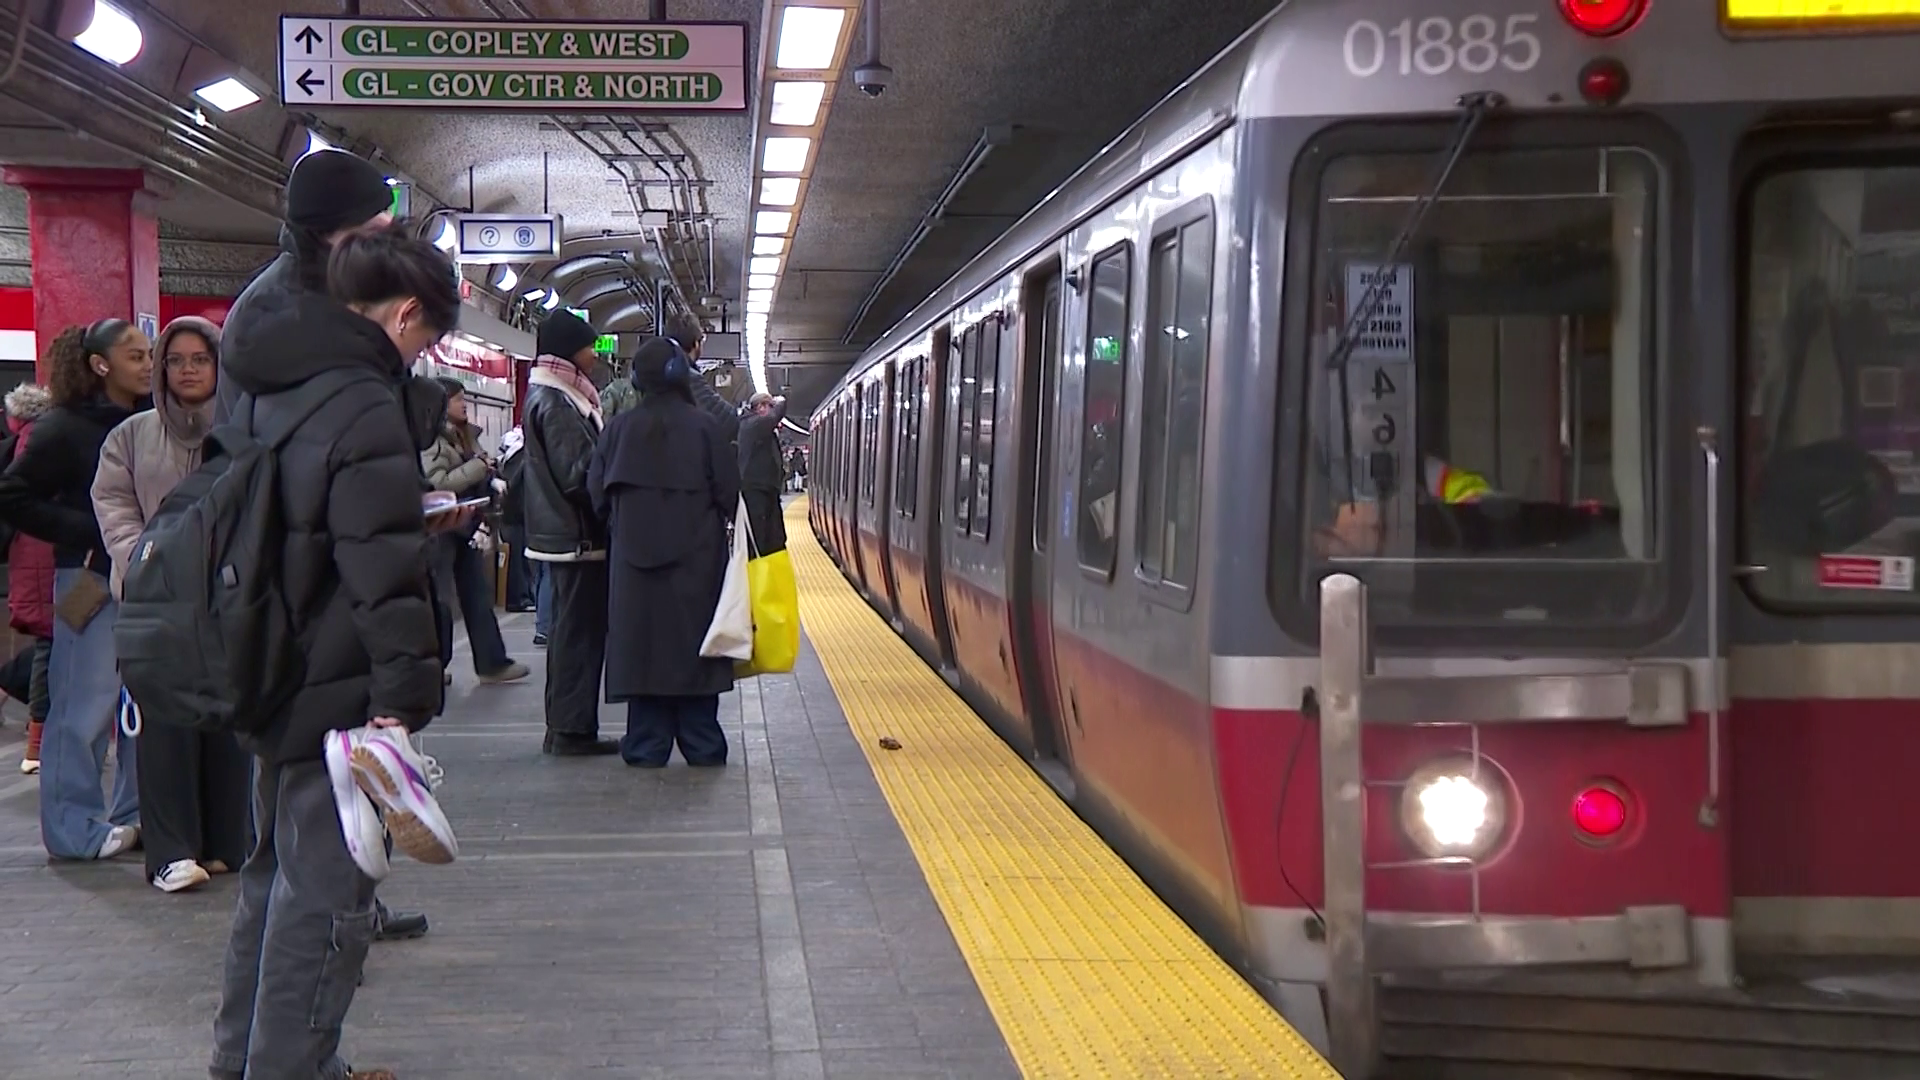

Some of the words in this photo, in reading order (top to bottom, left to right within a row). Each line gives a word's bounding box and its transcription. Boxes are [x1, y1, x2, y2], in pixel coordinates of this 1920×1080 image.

[356, 29, 398, 53] GL
[427, 30, 551, 55] COPLEY
[560, 32, 580, 55] &
[589, 33, 676, 56] WEST
[1343, 13, 1541, 77] 01885
[357, 71, 399, 95] GL
[428, 73, 495, 97] GOV
[503, 74, 565, 97] CTR
[574, 75, 594, 98] &
[604, 75, 709, 99] NORTH
